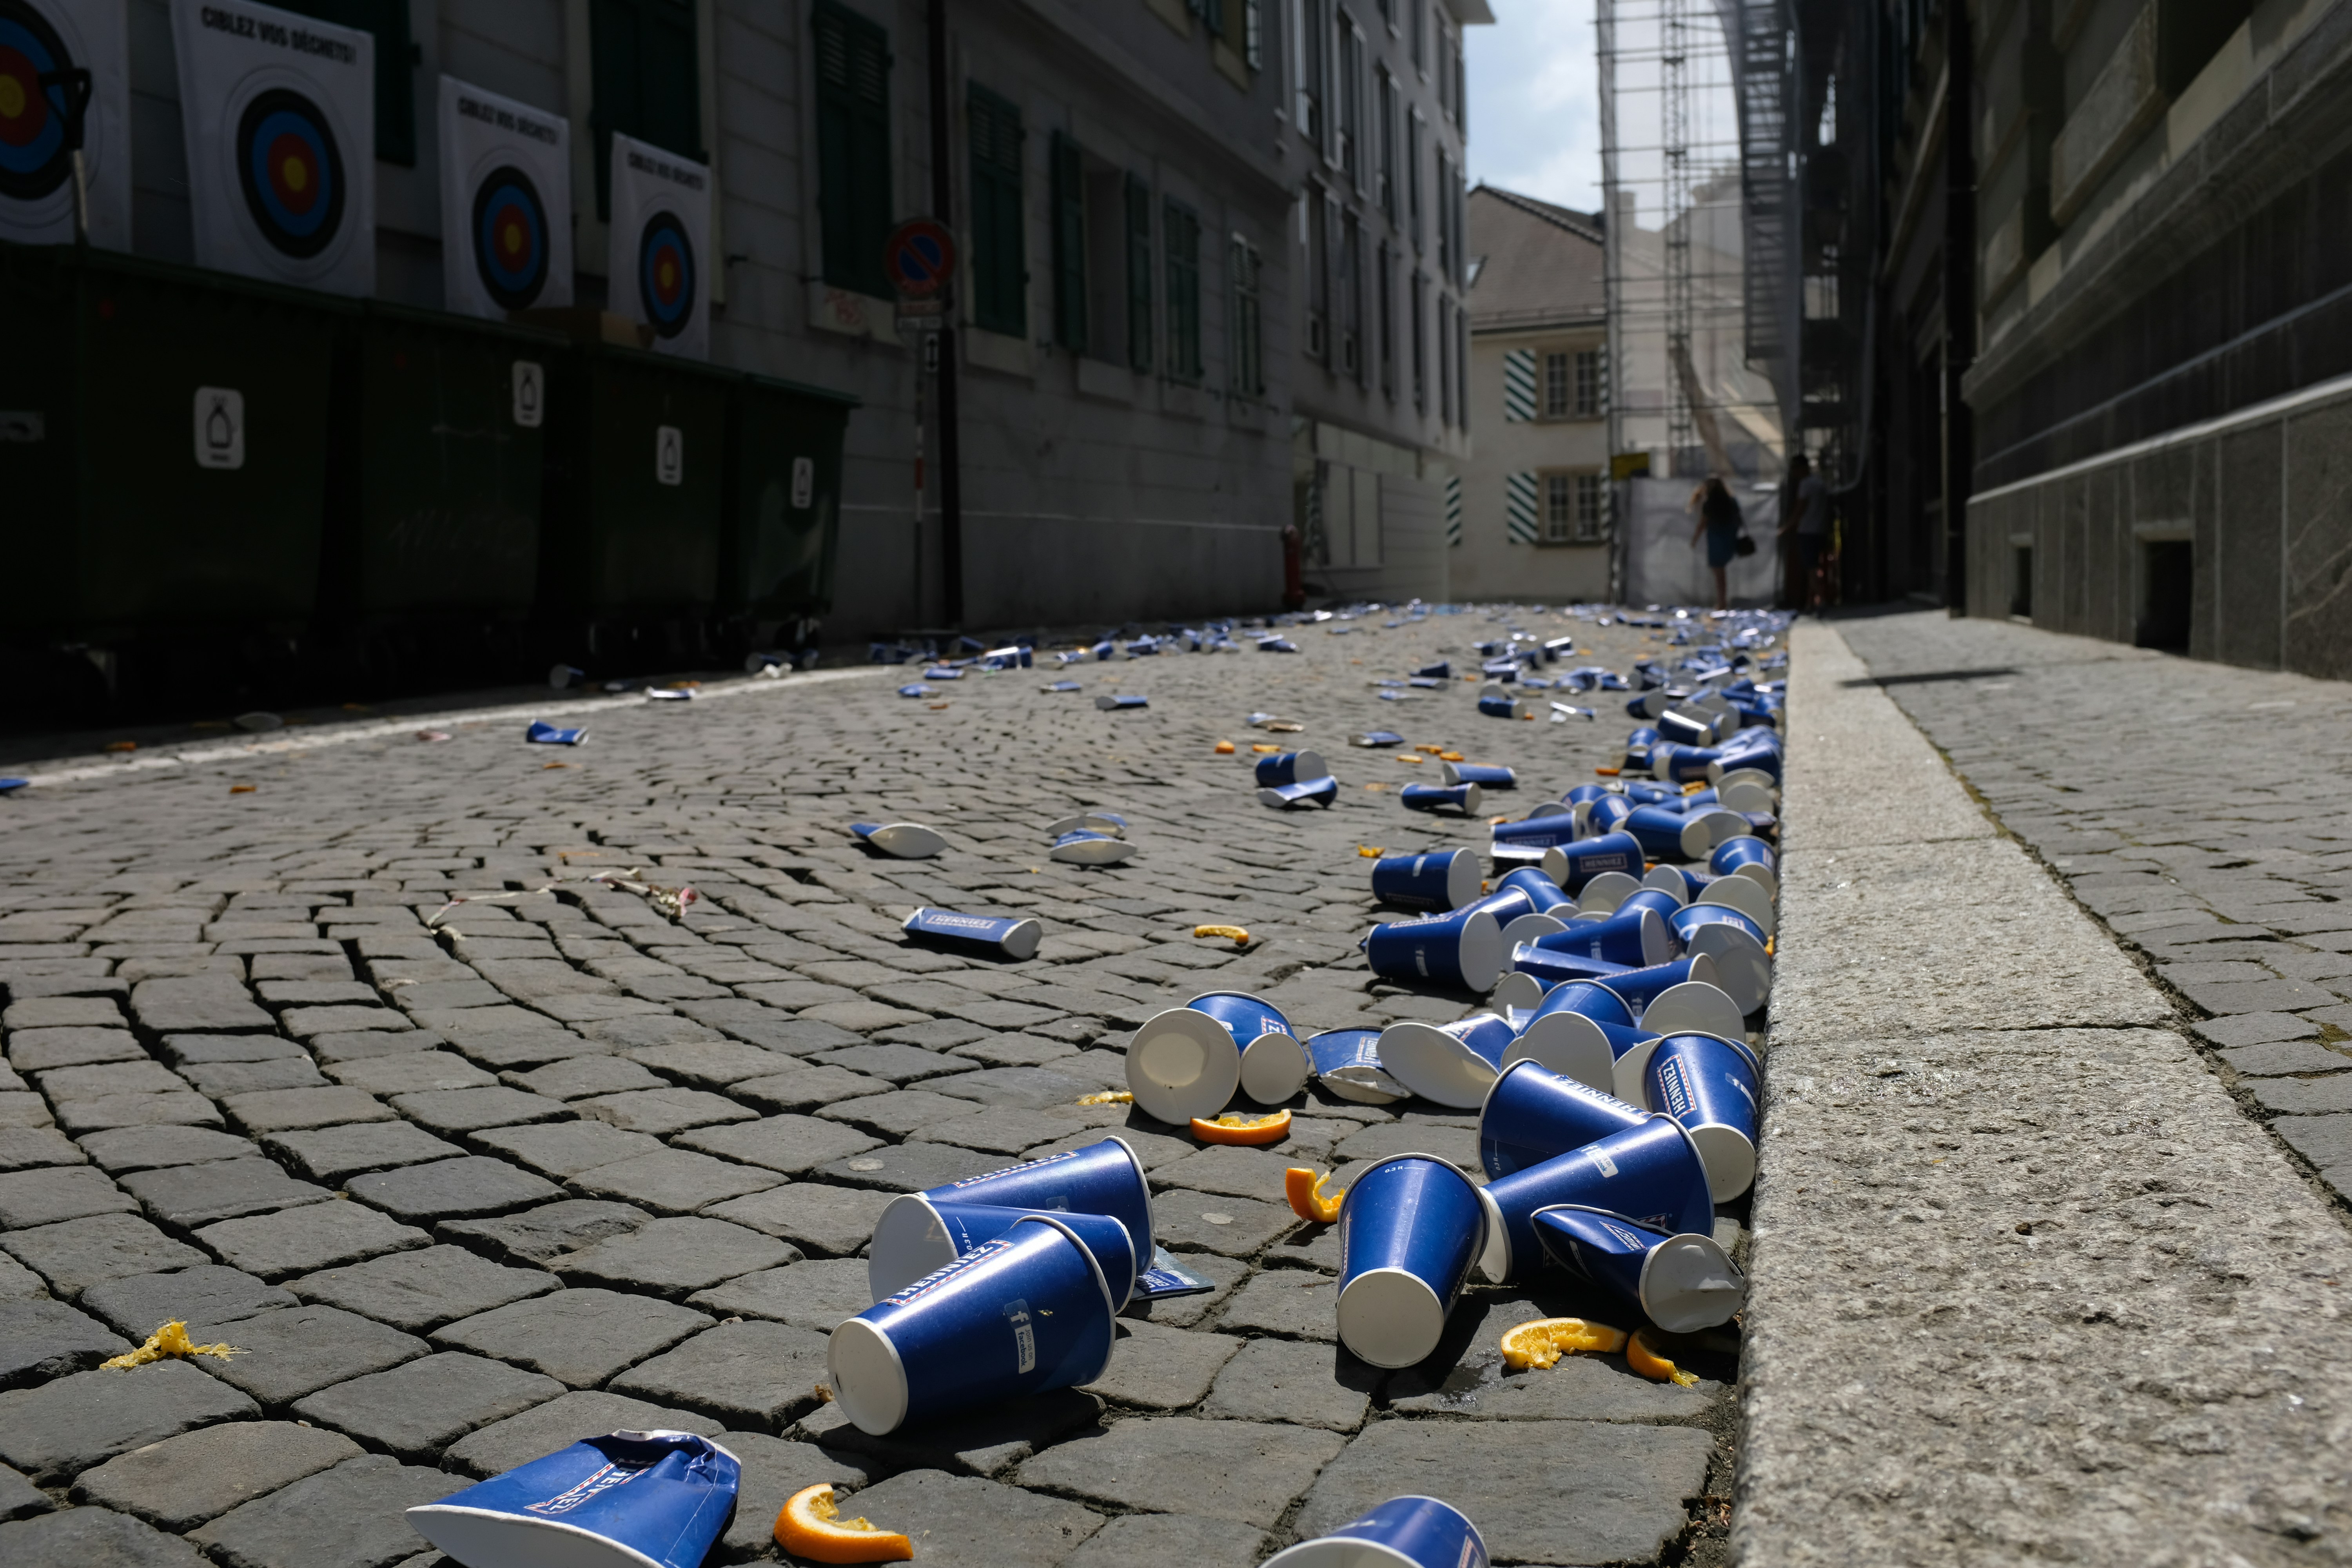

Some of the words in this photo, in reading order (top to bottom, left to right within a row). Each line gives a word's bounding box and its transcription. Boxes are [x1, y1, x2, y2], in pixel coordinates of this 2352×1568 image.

[201, 5, 254, 38] CIBLEZ
[258, 21, 288, 47] VOS
[1558, 1078, 1639, 1112] HENNIEZ
[1663, 1063, 1686, 1114] HENNIEZ
[964, 1239, 973, 1250] 0.3
[896, 1245, 994, 1296] HENNIEZ
[1138, 1274, 1170, 1287] ENERG
[1018, 1331, 1027, 1368] facebook
[1028, 1352, 1033, 1360] on
